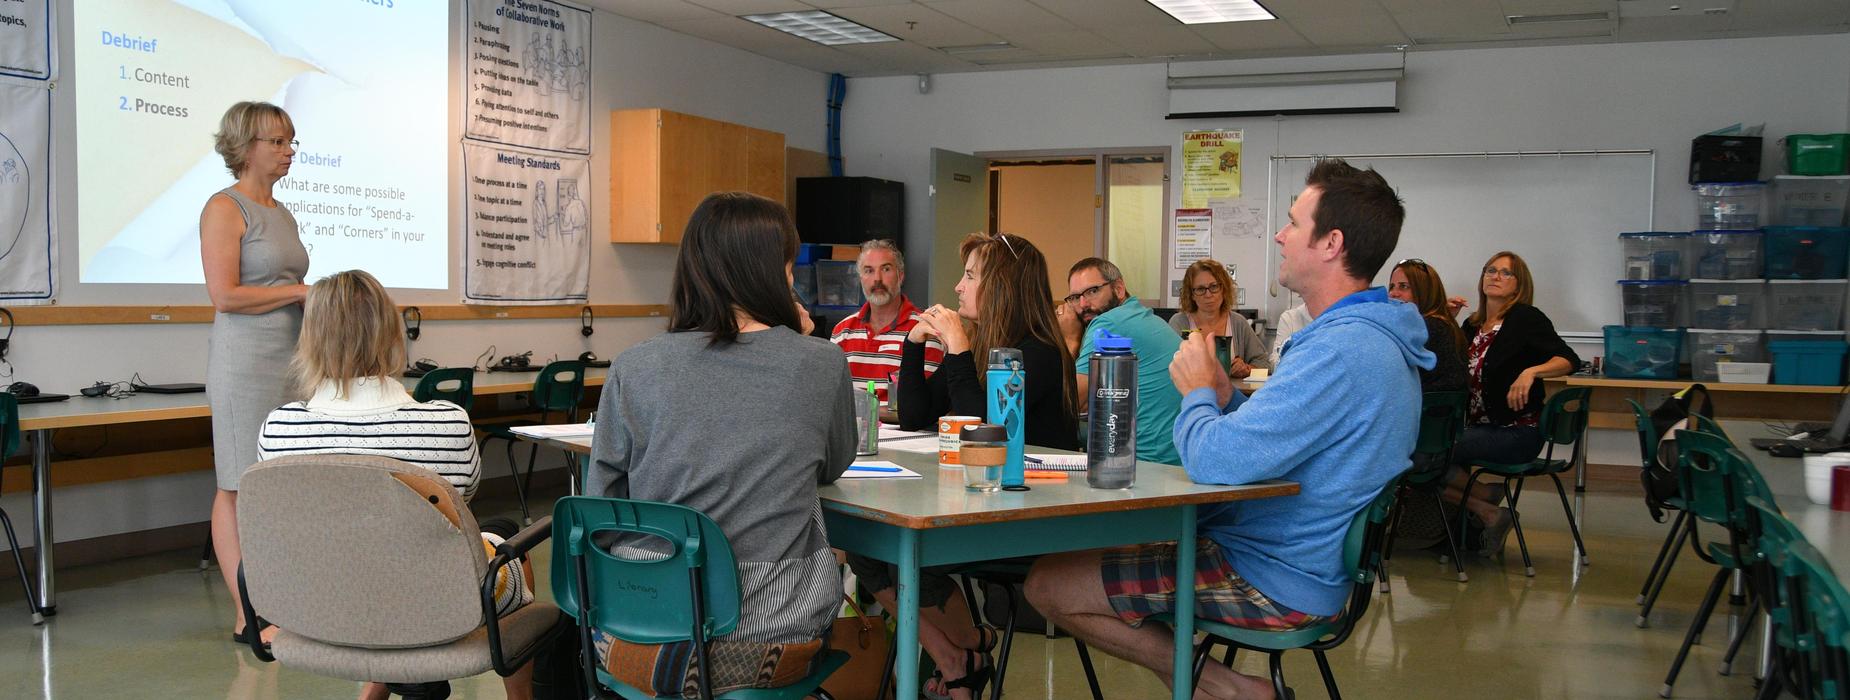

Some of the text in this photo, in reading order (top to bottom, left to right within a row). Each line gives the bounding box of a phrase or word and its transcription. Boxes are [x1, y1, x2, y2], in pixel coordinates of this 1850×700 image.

[517, 0, 538, 13] Seven
[539, 6, 560, 18] Norms
[478, 21, 500, 34] Pausing
[495, 7, 565, 32] of Collaborative Work
[101, 30, 158, 53] Debrief
[479, 37, 511, 52] Paraphrasing
[479, 53, 497, 64] Posing
[498, 58, 519, 68] uestions
[118, 65, 190, 89] 1. Content
[480, 68, 498, 80] Putting
[517, 76, 525, 84] the
[526, 78, 539, 87] table
[118, 95, 189, 118] 2. Process
[496, 102, 516, 113] attention
[524, 108, 535, 116] self
[543, 111, 559, 120] others
[479, 114, 502, 127] Presuming
[502, 120, 523, 129] positive
[523, 122, 548, 132] intentions
[1184, 132, 1241, 141] EARTHQUAKE
[300, 151, 342, 168] Debrief
[497, 153, 561, 171] Meeting Standards
[278, 177, 406, 201] What are some possible
[486, 178, 505, 188] process
[516, 181, 528, 189] time
[284, 200, 345, 216] pplications
[347, 203, 363, 217] for
[486, 195, 499, 205] topic
[510, 198, 522, 206] time
[495, 213, 528, 224] participation
[314, 224, 335, 236] and
[391, 228, 400, 240] in
[402, 231, 425, 244] your
[515, 234, 530, 242] agree
[517, 260, 536, 269] conflict
[1106, 412, 1119, 454] everyday
[617, 580, 659, 599] Library
